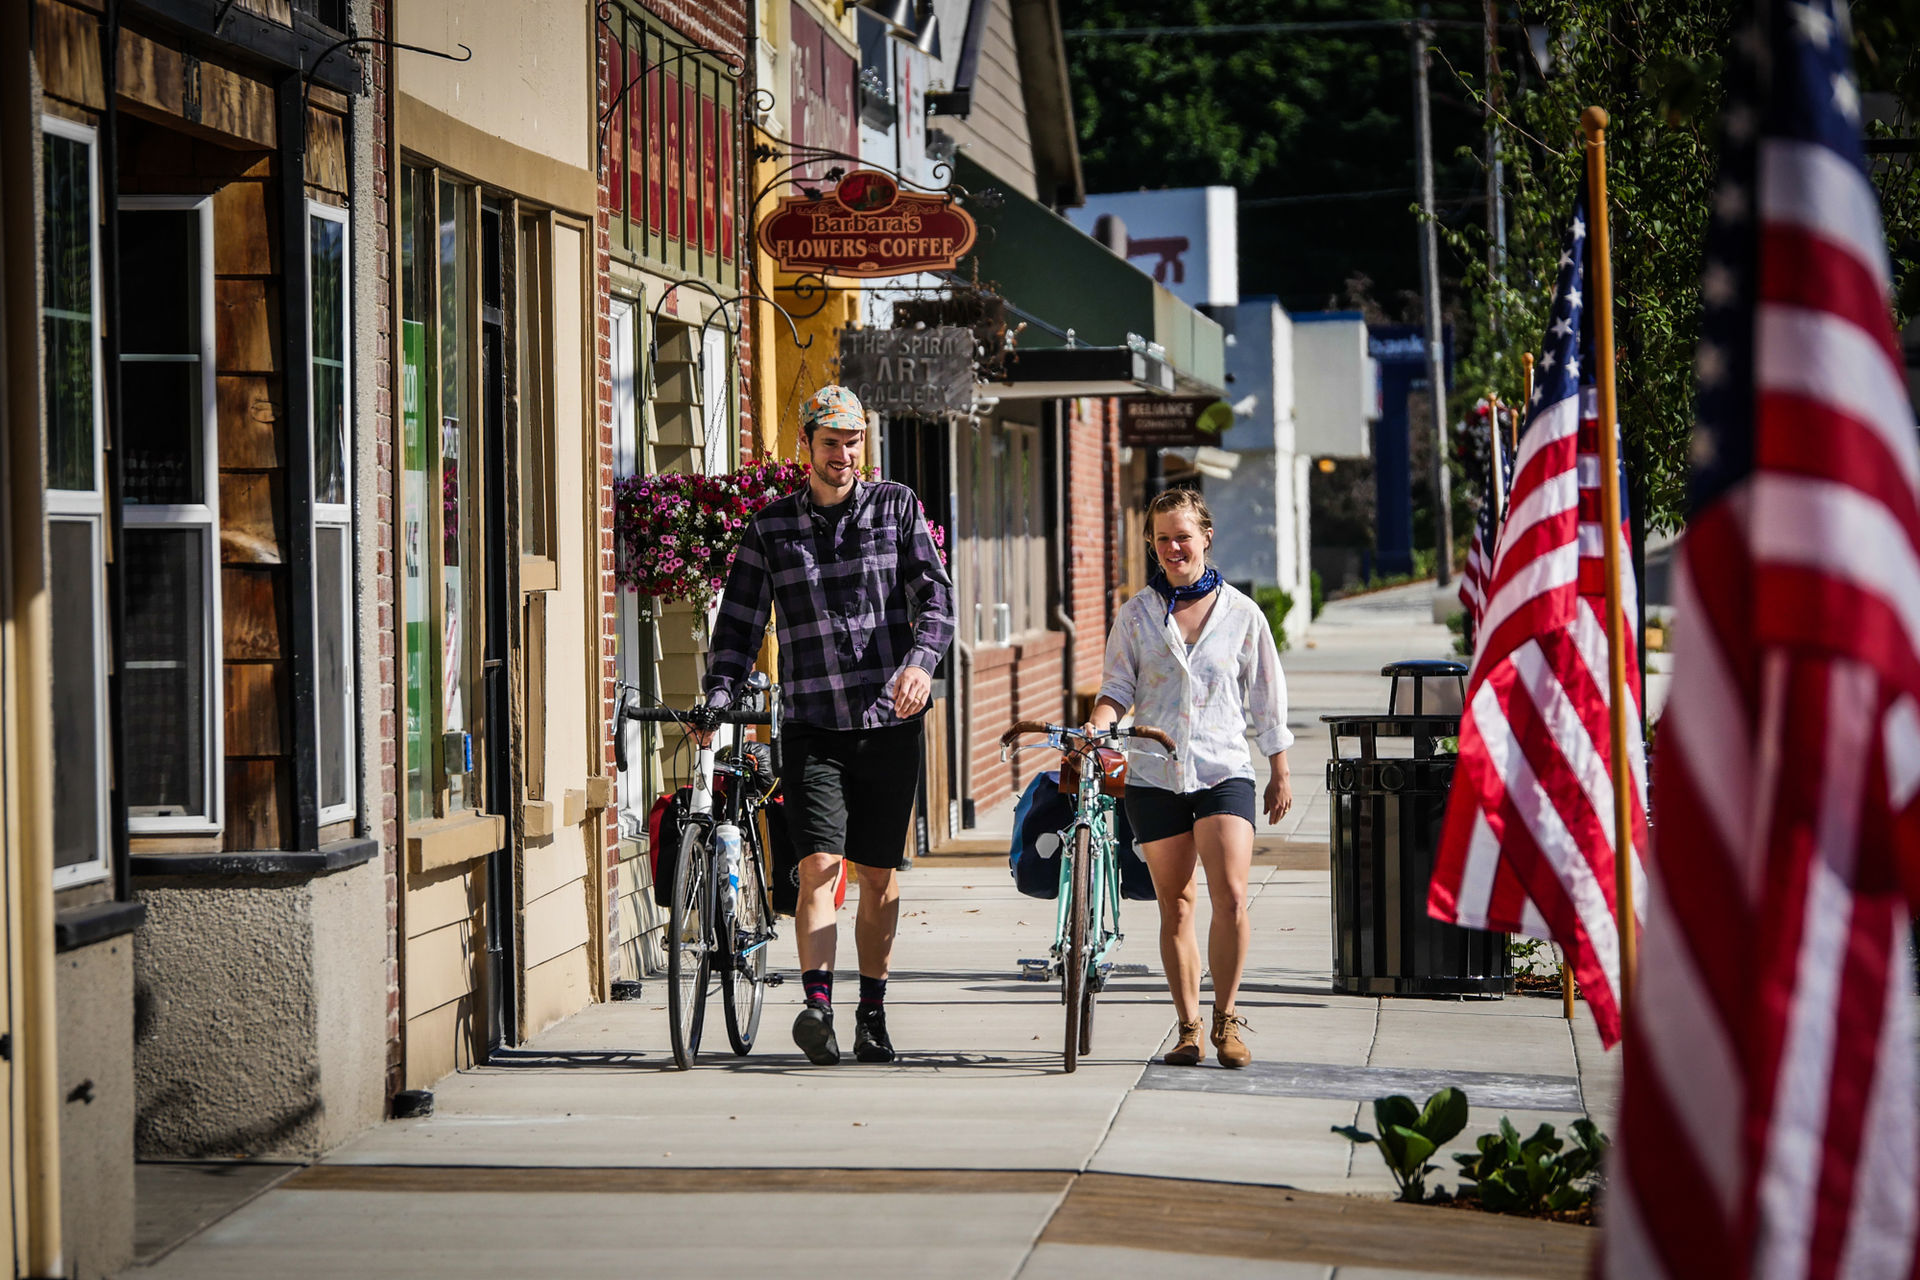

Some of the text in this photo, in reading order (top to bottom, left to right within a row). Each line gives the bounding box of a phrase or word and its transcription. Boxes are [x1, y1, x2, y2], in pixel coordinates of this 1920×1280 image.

[812, 212, 922, 234] Barbara's
[776, 238, 867, 258] FLOWERS
[879, 237, 955, 257] COFFEE
[849, 333, 886, 355] THE
[876, 356, 938, 383] ART
[1128, 402, 1194, 417] RELIANCE
